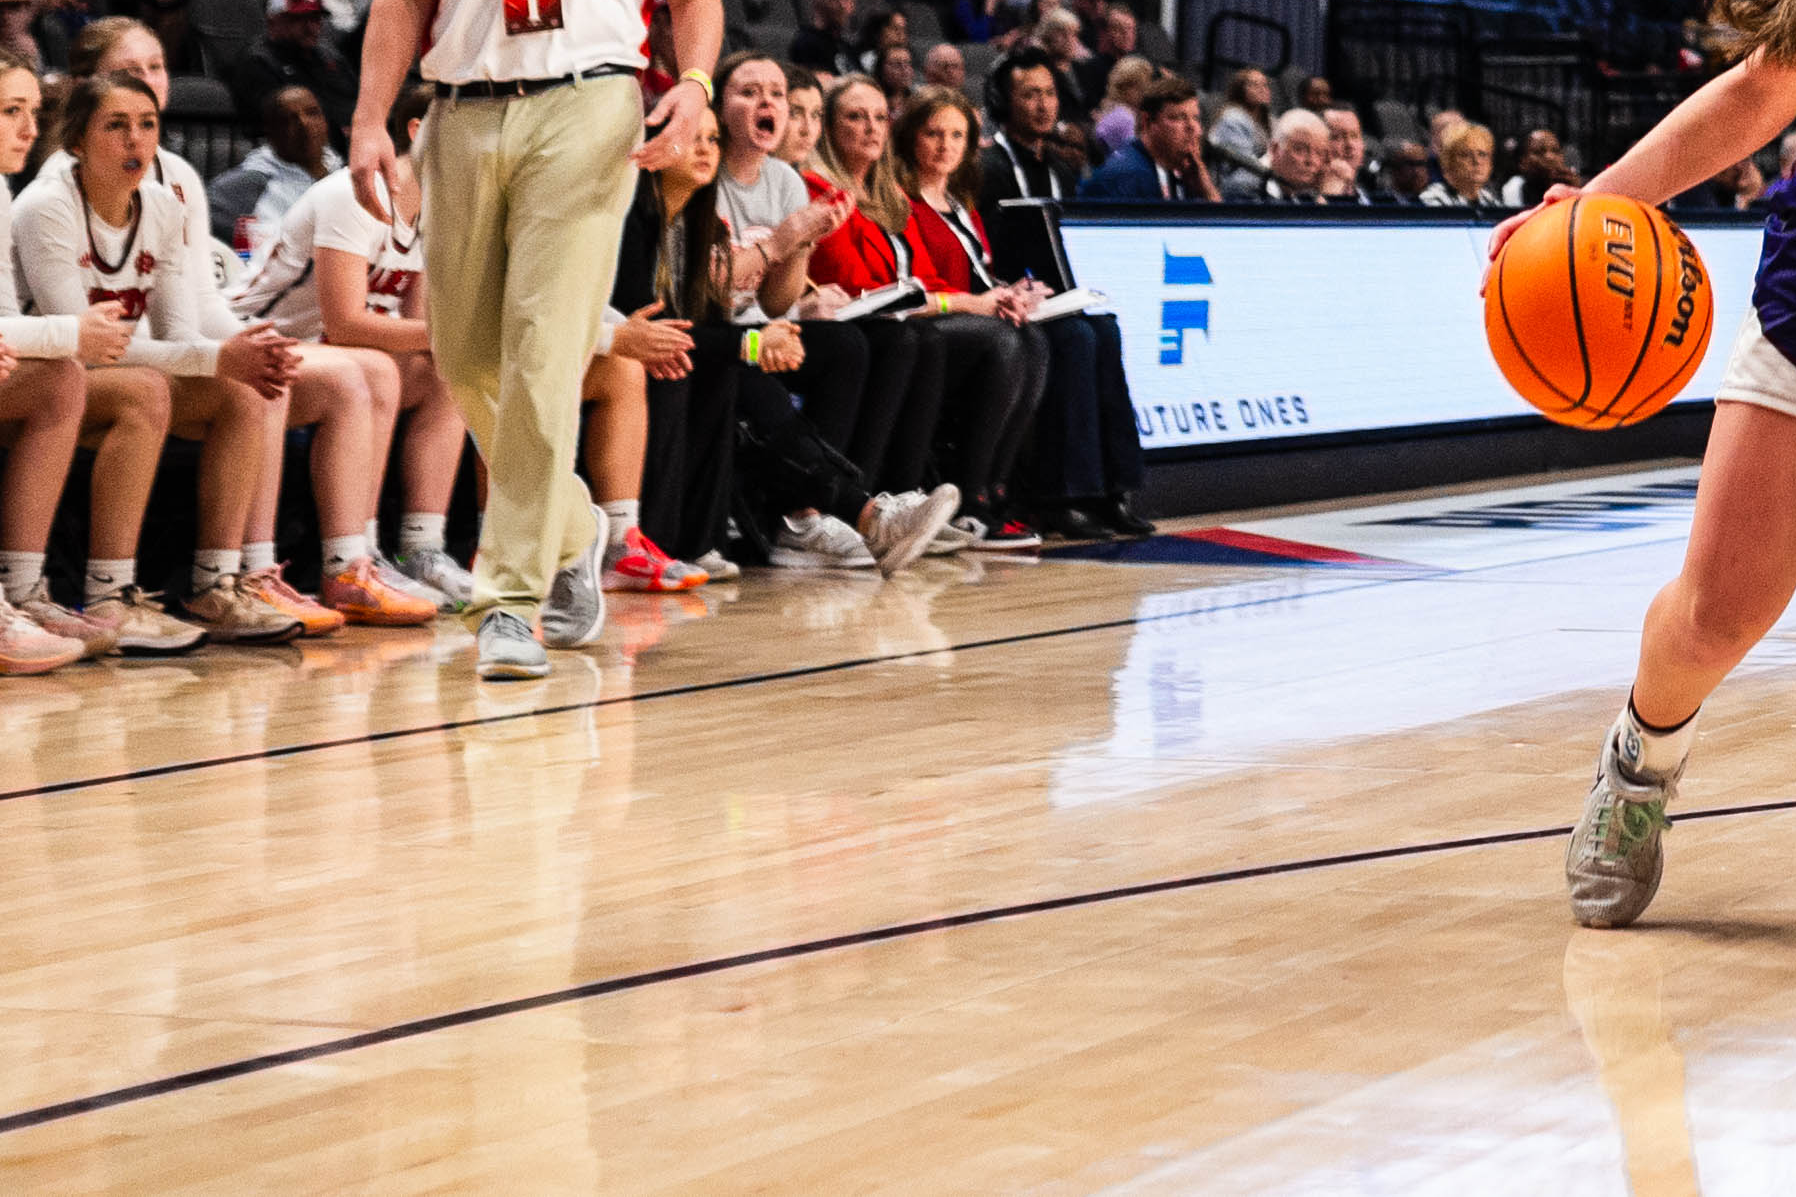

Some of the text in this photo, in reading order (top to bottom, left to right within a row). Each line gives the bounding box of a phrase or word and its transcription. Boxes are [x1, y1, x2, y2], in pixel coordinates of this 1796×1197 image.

[1603, 215, 1635, 299] EVO
[1134, 396, 1309, 436] UTURE ONES
